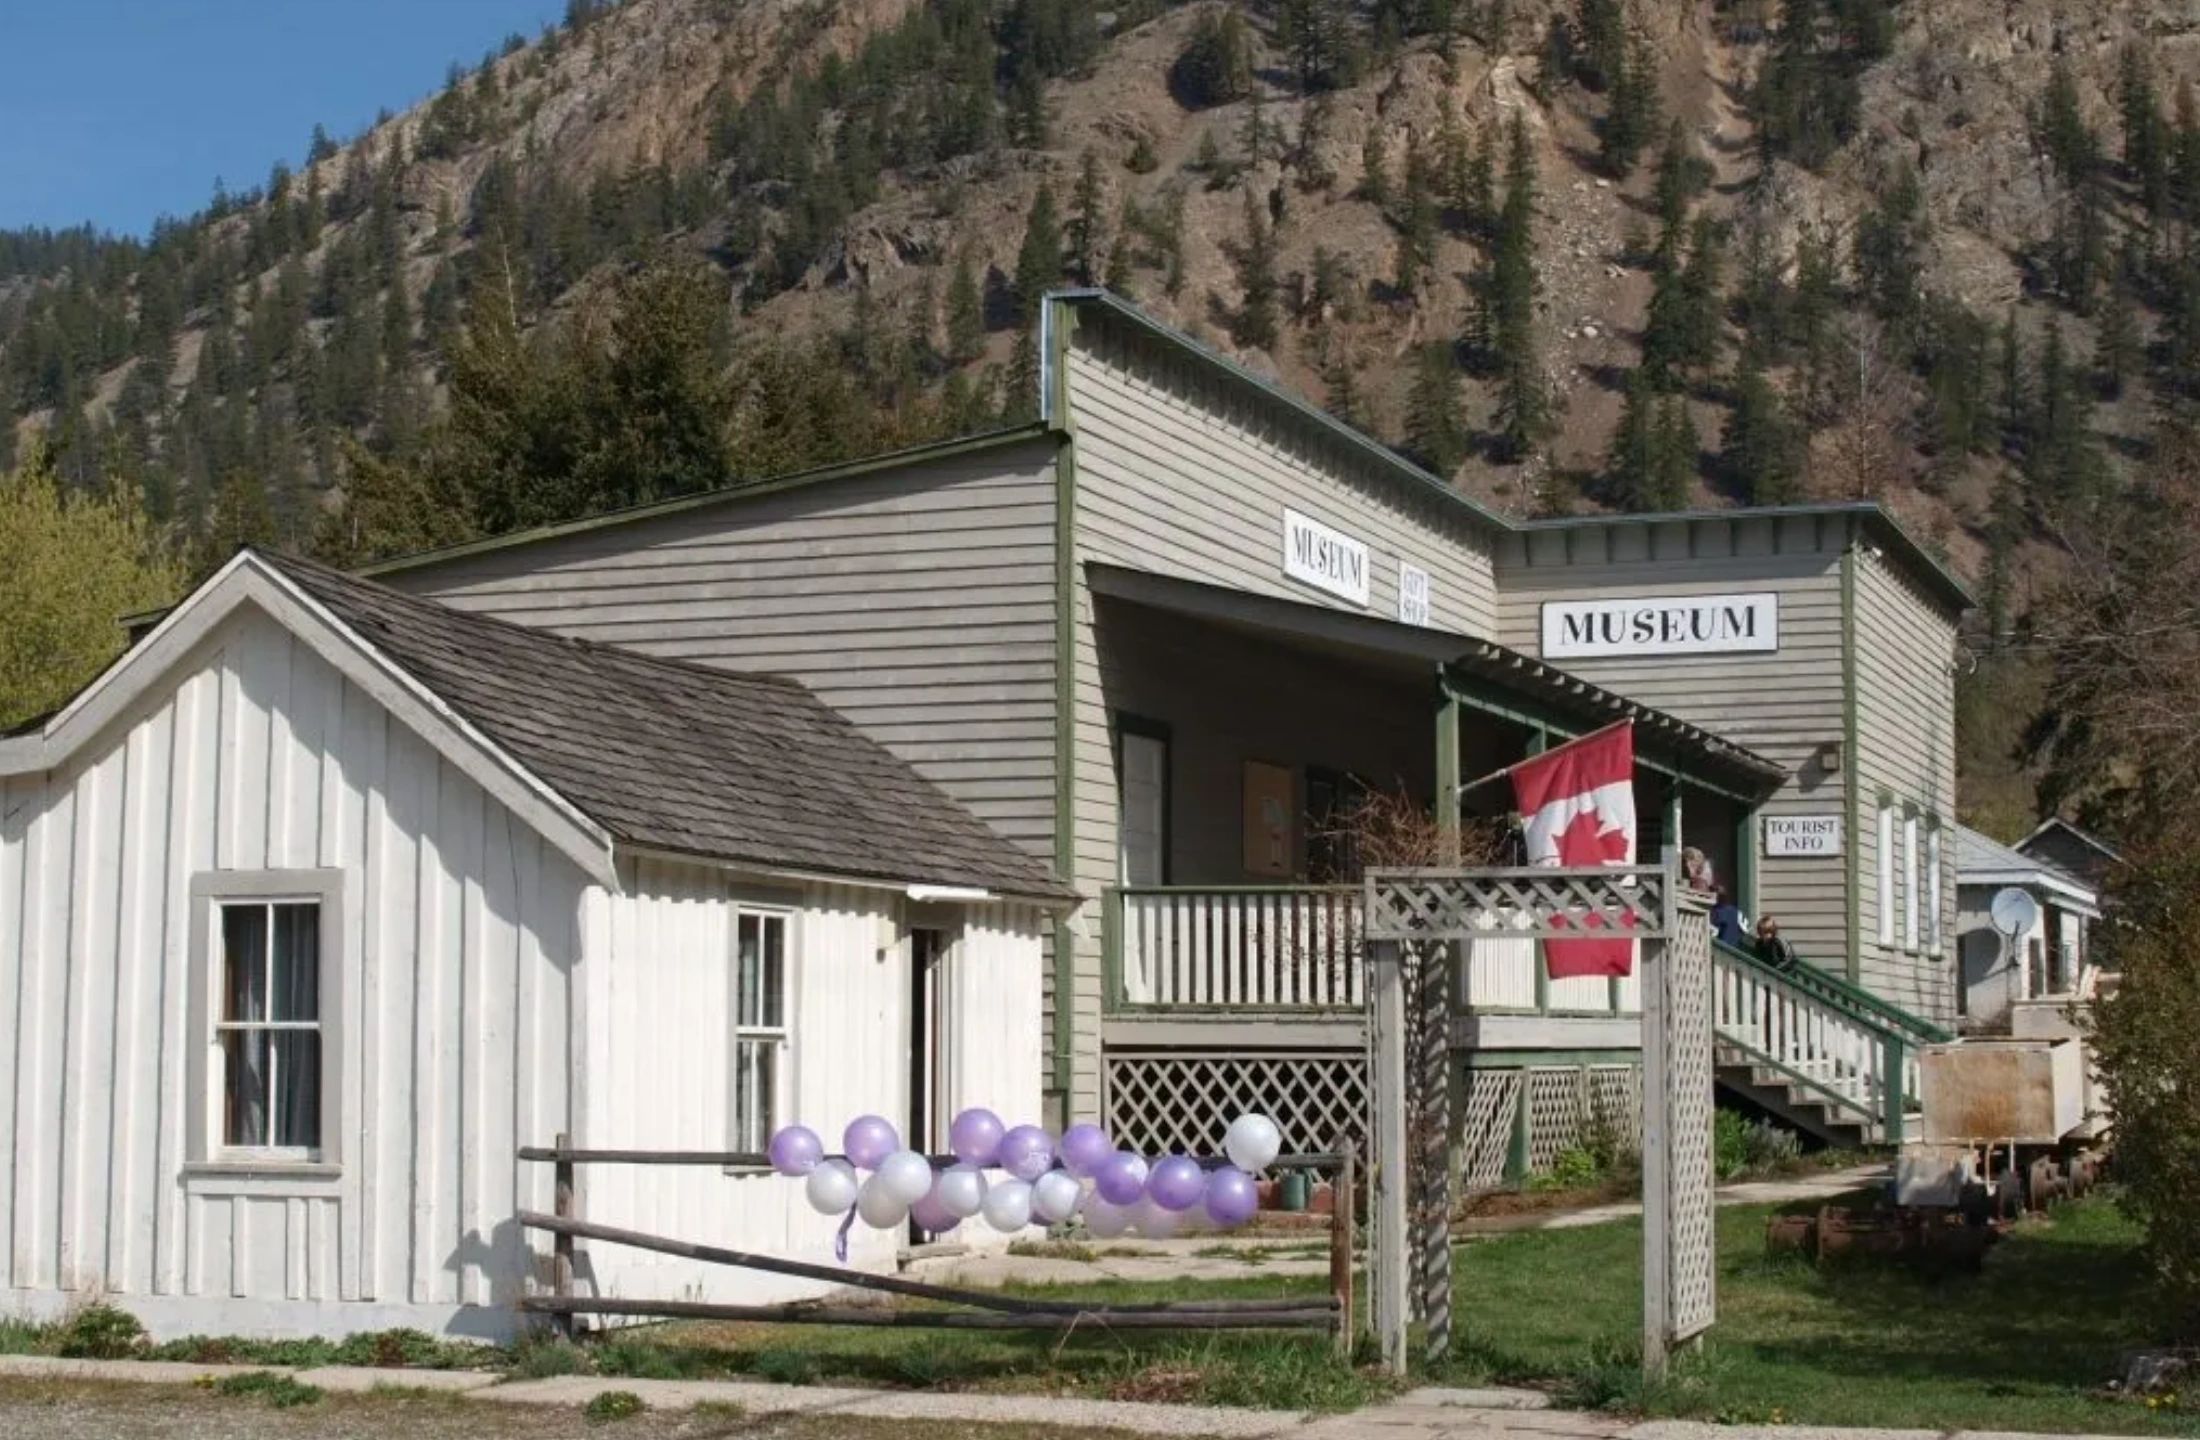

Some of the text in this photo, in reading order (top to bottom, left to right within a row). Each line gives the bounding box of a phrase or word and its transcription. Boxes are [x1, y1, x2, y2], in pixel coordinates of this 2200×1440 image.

[1293, 525, 1362, 590] MUSEUM
[1561, 606, 1756, 645] MUSEUM
[1771, 820, 1834, 834] TOURIST
[1785, 836, 1823, 850] INFO
